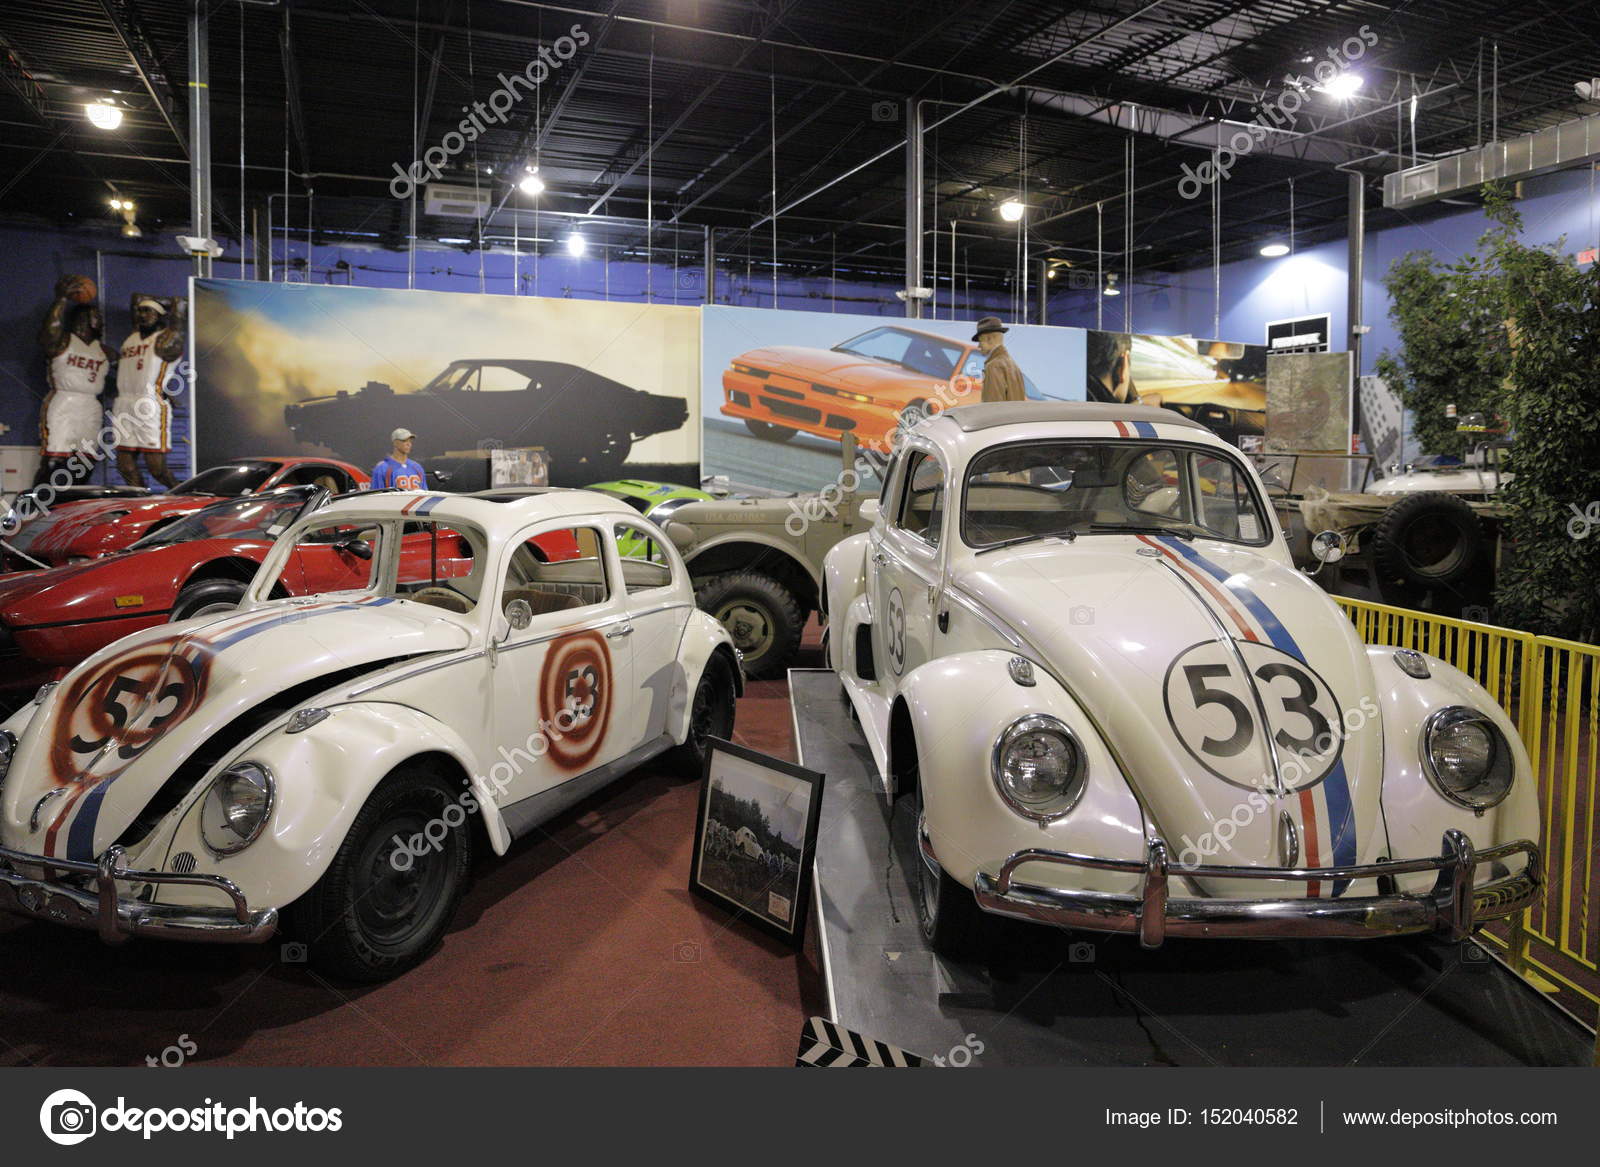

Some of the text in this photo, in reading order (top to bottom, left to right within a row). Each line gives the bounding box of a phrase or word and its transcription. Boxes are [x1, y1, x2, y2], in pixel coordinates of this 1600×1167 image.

[67, 354, 104, 372] HEAT
[88, 372, 97, 383] 3
[889, 600, 904, 665] 53
[70, 675, 186, 760] 53
[566, 665, 601, 717] 53
[1183, 663, 1332, 758] 53
